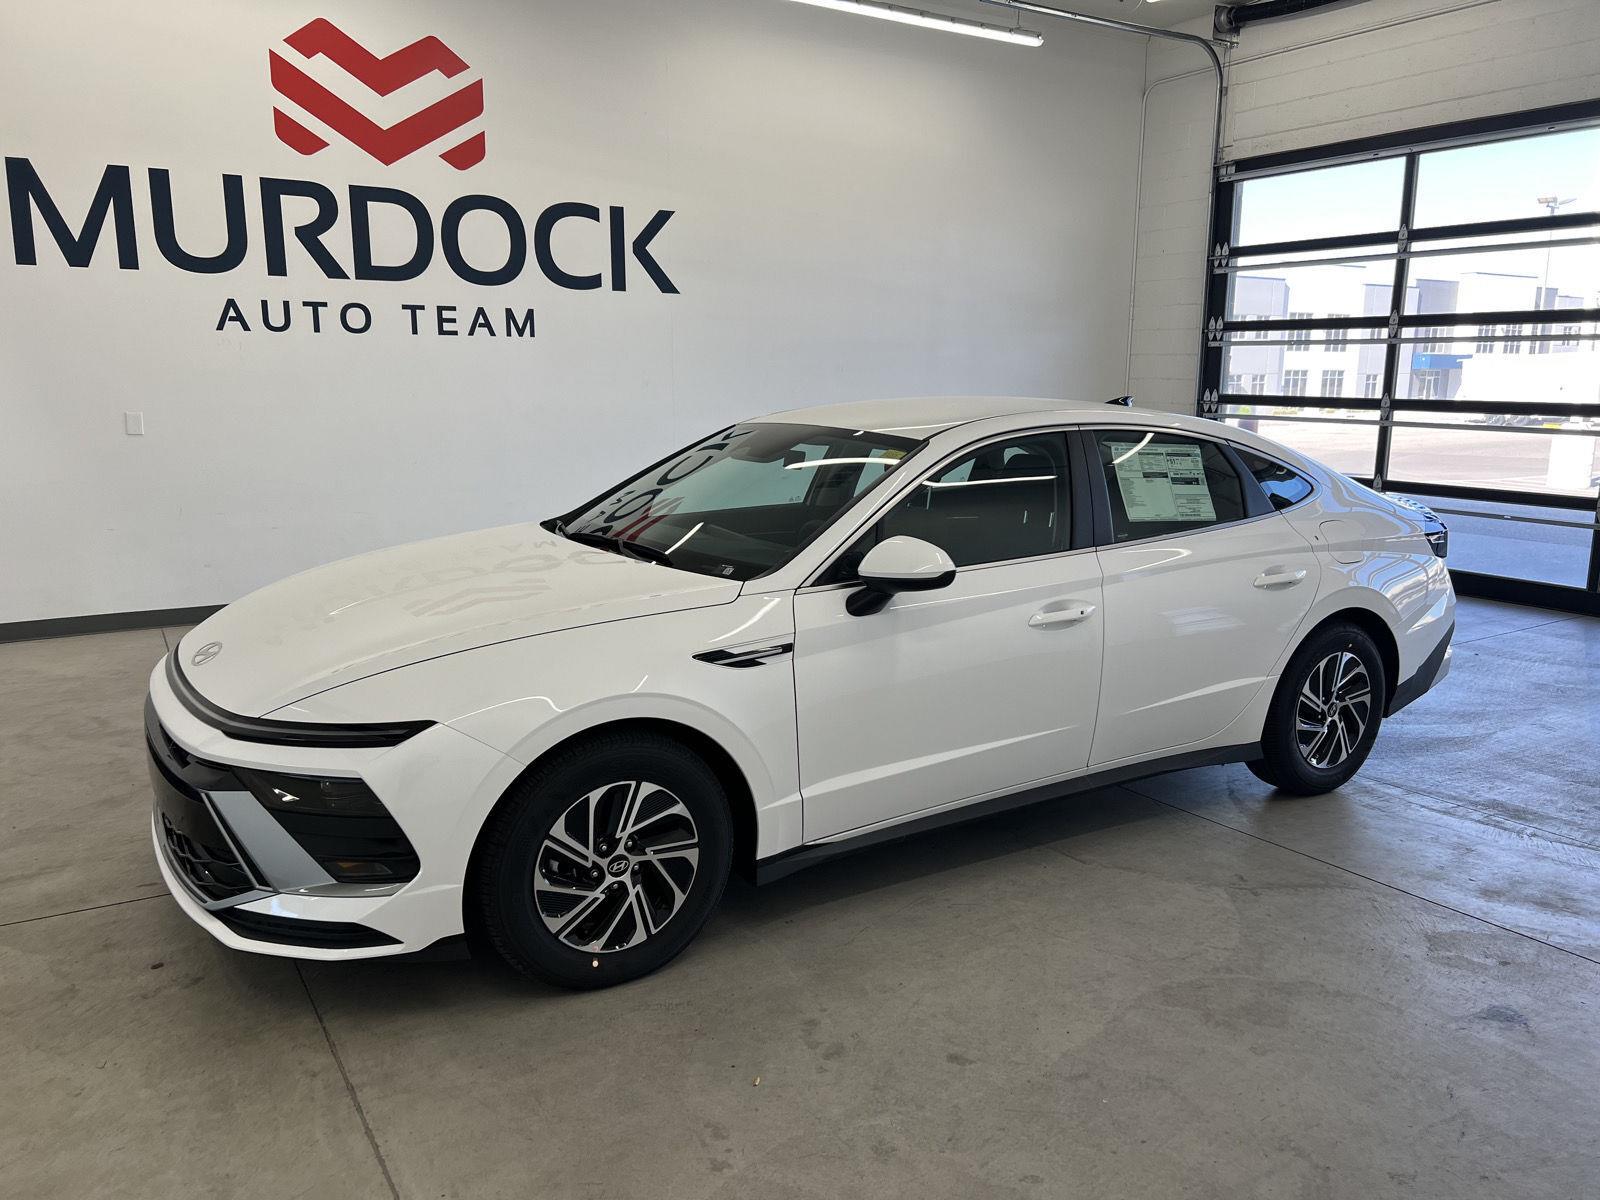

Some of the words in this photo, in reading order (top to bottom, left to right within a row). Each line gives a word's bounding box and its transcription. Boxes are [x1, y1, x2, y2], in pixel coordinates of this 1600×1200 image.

[5, 157, 680, 294] MURDOCK
[216, 298, 372, 334] AUTO
[402, 304, 536, 338] TEAM
